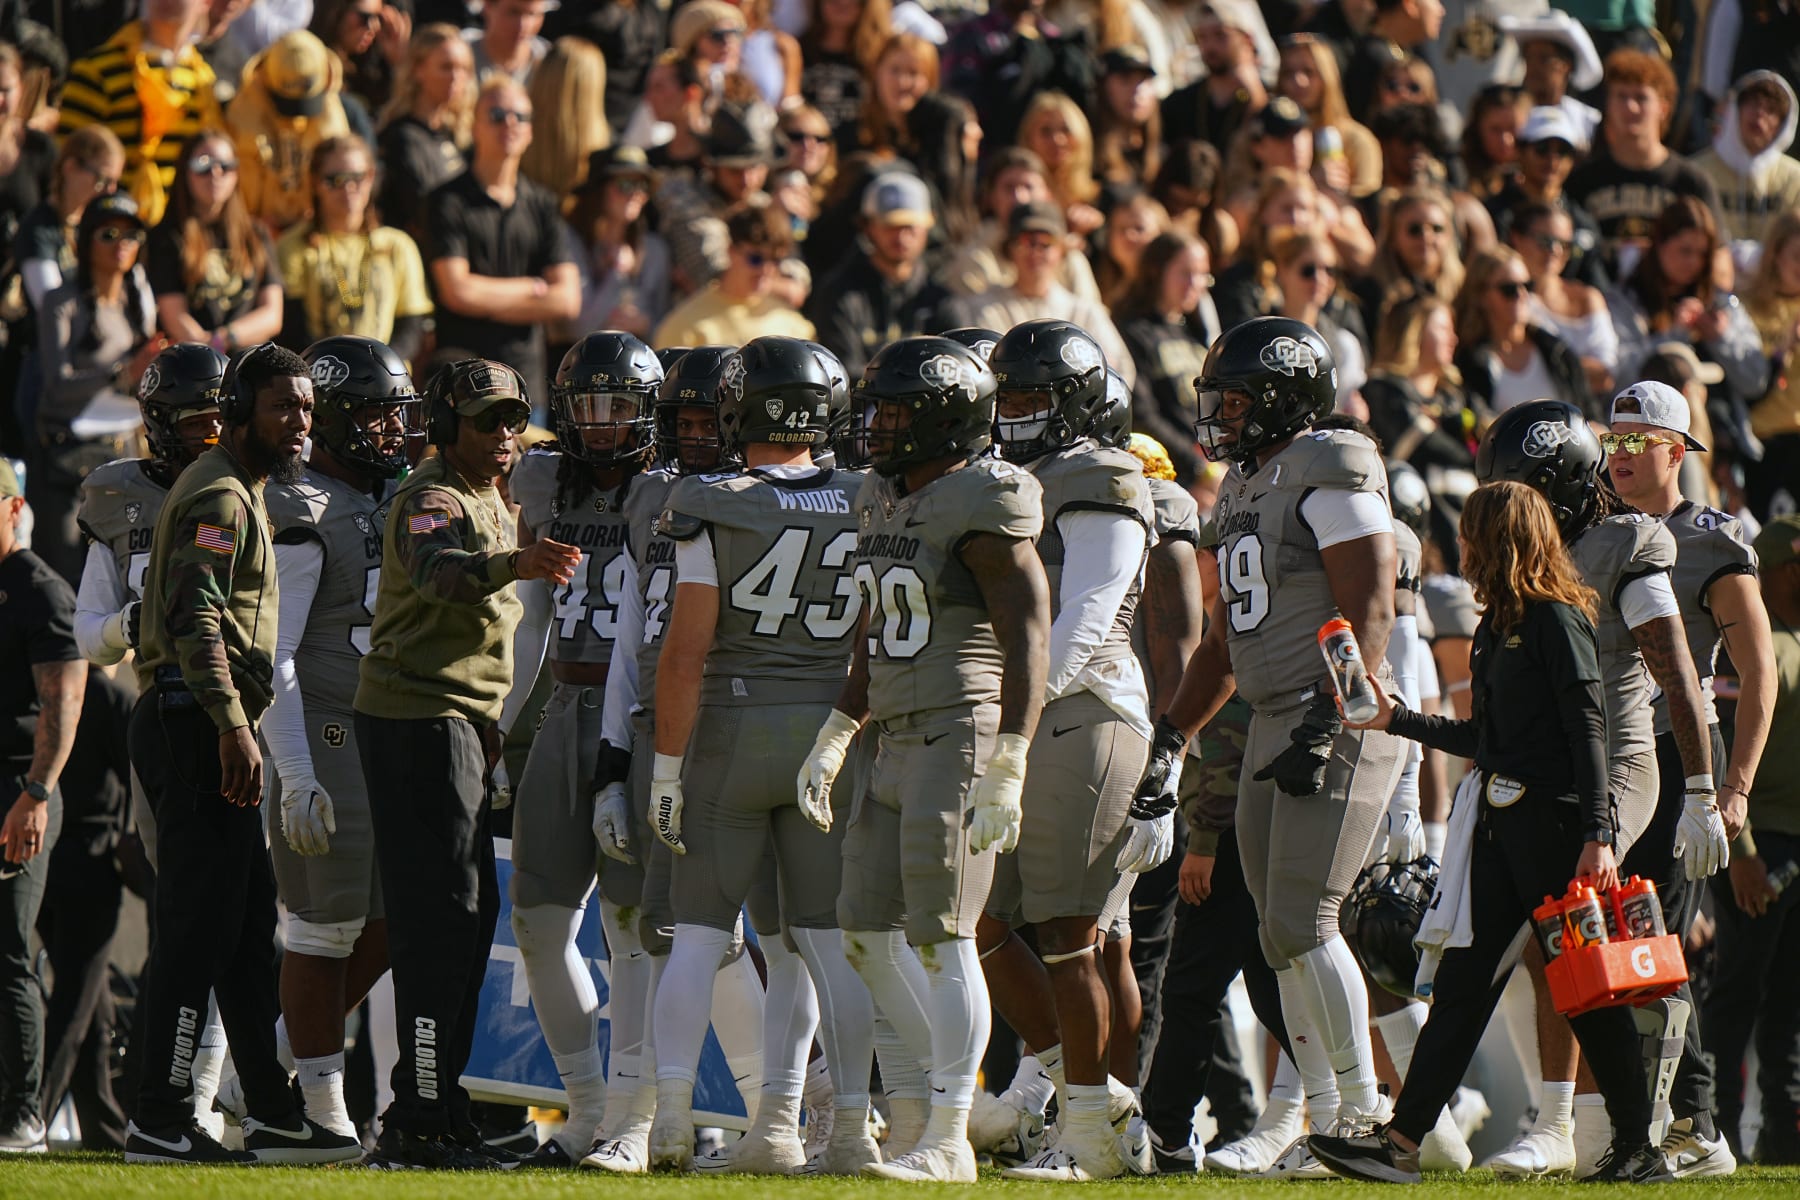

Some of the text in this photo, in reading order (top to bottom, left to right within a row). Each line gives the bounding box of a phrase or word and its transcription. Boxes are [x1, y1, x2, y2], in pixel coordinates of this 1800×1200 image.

[1275, 341, 1300, 367] CU
[474, 369, 506, 380] COLORADO
[785, 411, 810, 429] 43
[768, 432, 815, 443] COLORADO
[1532, 423, 1561, 448] CU
[593, 497, 607, 513] CU
[773, 488, 849, 514] WOODS
[551, 551, 629, 641] 49
[730, 526, 863, 642] 43
[322, 723, 347, 748] CU
[658, 795, 680, 845] COLORADO
[1580, 915, 1602, 940] G
[1631, 945, 1657, 978] G
[169, 1006, 198, 1088] COLORADO
[415, 1016, 438, 1100] COLORADO
